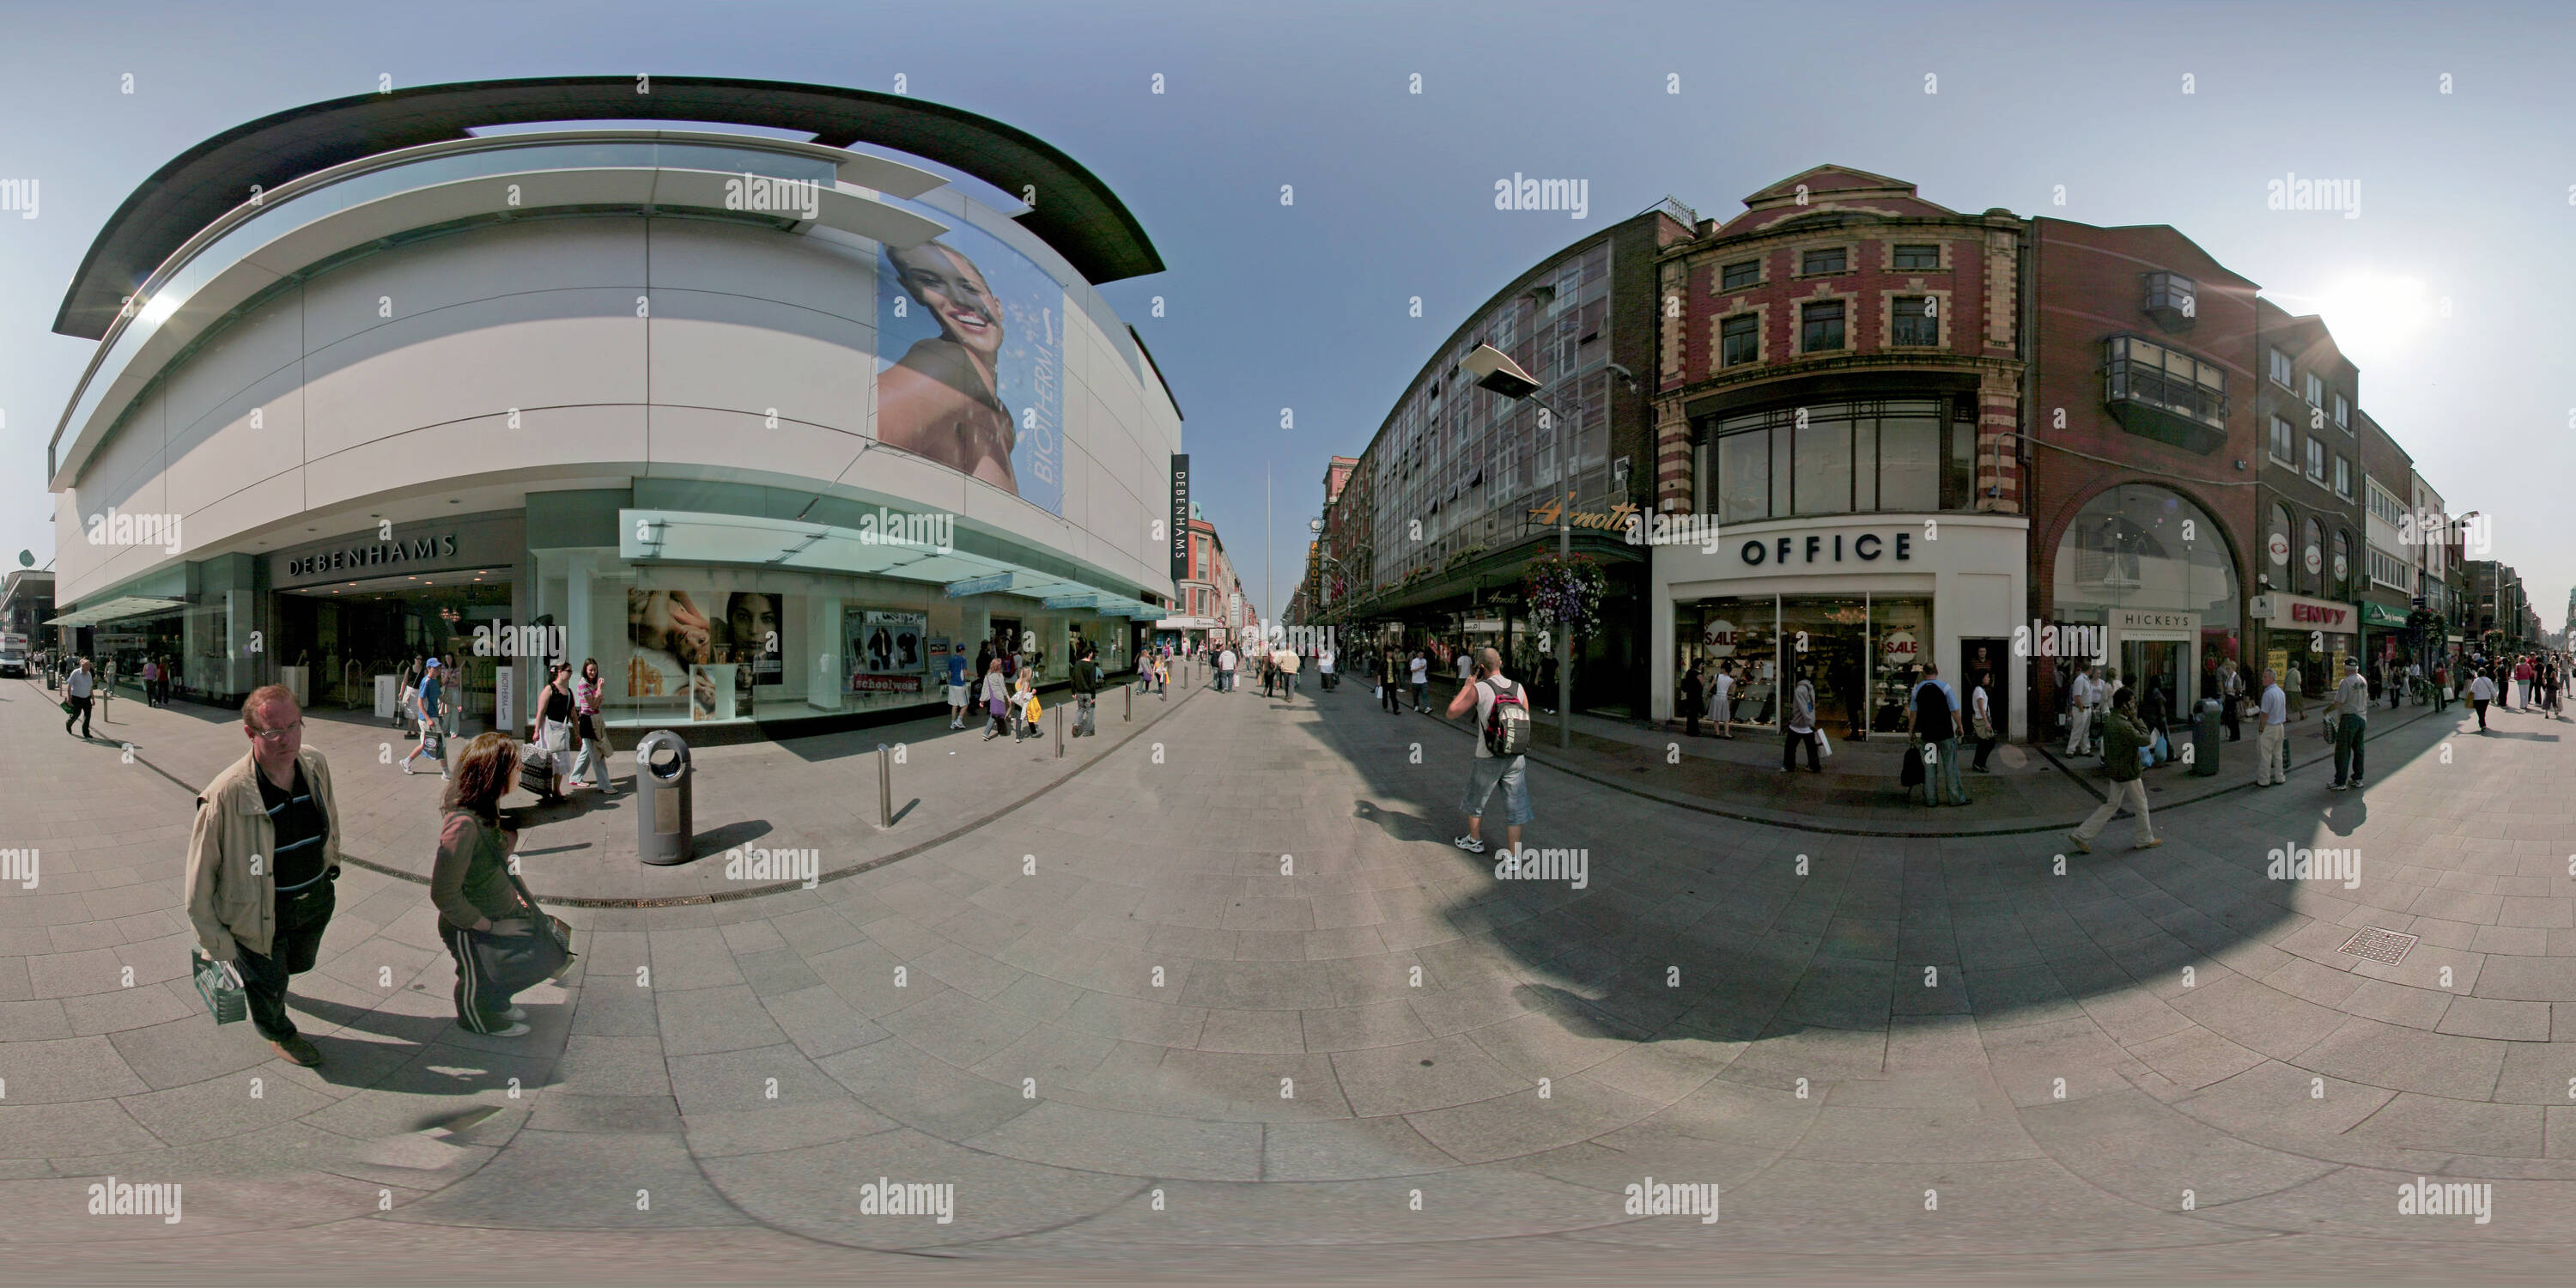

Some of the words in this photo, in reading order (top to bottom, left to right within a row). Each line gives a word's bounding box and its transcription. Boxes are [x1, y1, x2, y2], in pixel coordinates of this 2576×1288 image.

[1034, 343, 1054, 485] BIOTHERM
[1176, 471, 1186, 559] DEBENHAMS
[289, 535, 458, 576] DEBENHAMS
[1741, 532, 1911, 566] OFFICE
[1487, 591, 1519, 605] Arnotts
[2125, 614, 2190, 626] HICKEYS
[2293, 603, 2348, 625] ENVY
[1705, 631, 1739, 646] SALE
[1886, 641, 1917, 653] SALE
[856, 677, 919, 691] schoolwear
